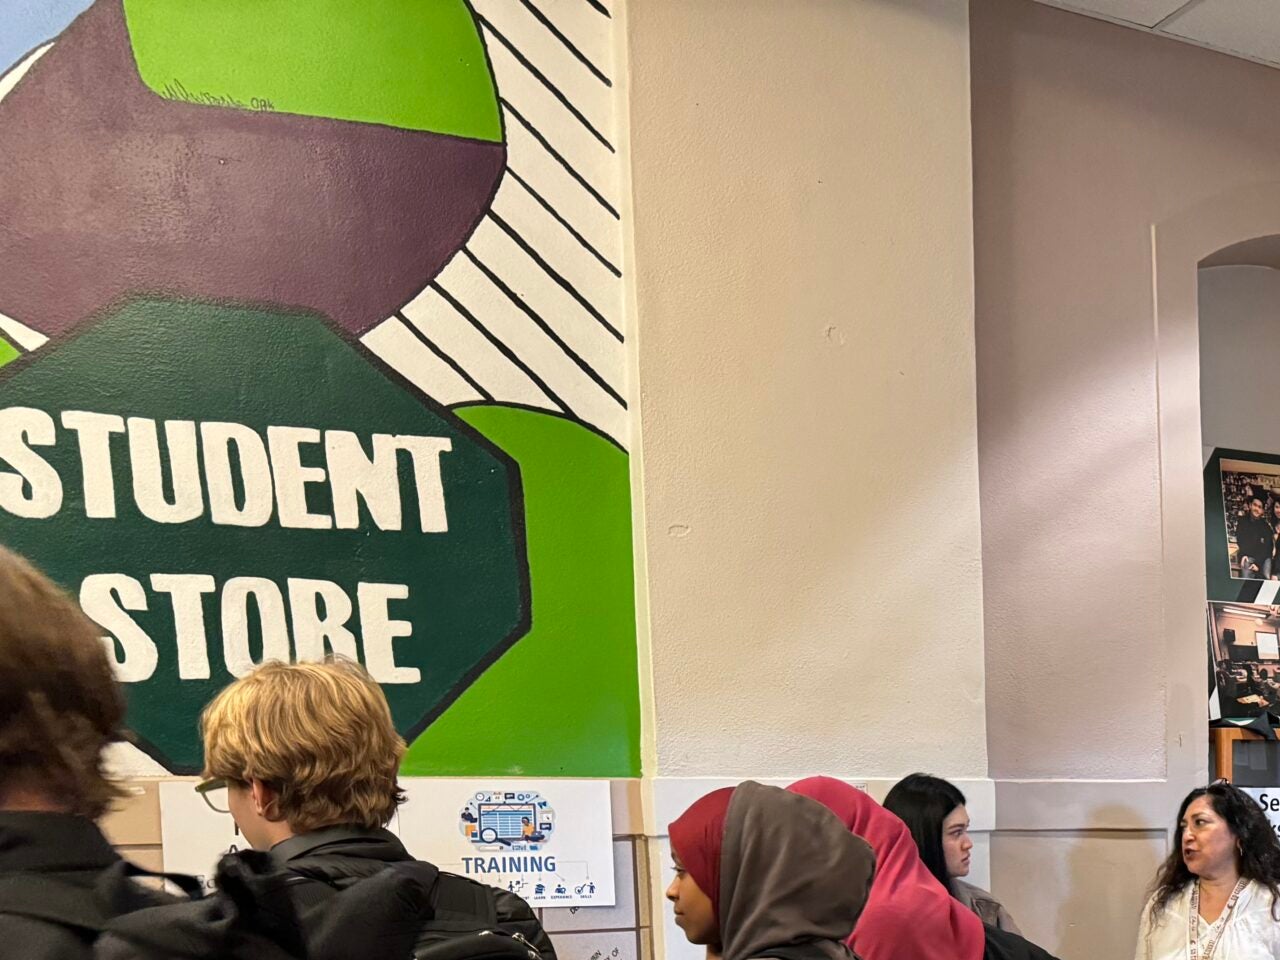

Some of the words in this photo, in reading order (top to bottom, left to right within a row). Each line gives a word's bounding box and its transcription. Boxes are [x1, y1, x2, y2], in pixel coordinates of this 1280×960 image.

[0, 406, 452, 533] STUDENT
[79, 572, 422, 684] STORE
[461, 856, 556, 874] TRAINING
[611, 947, 620, 957] OF
